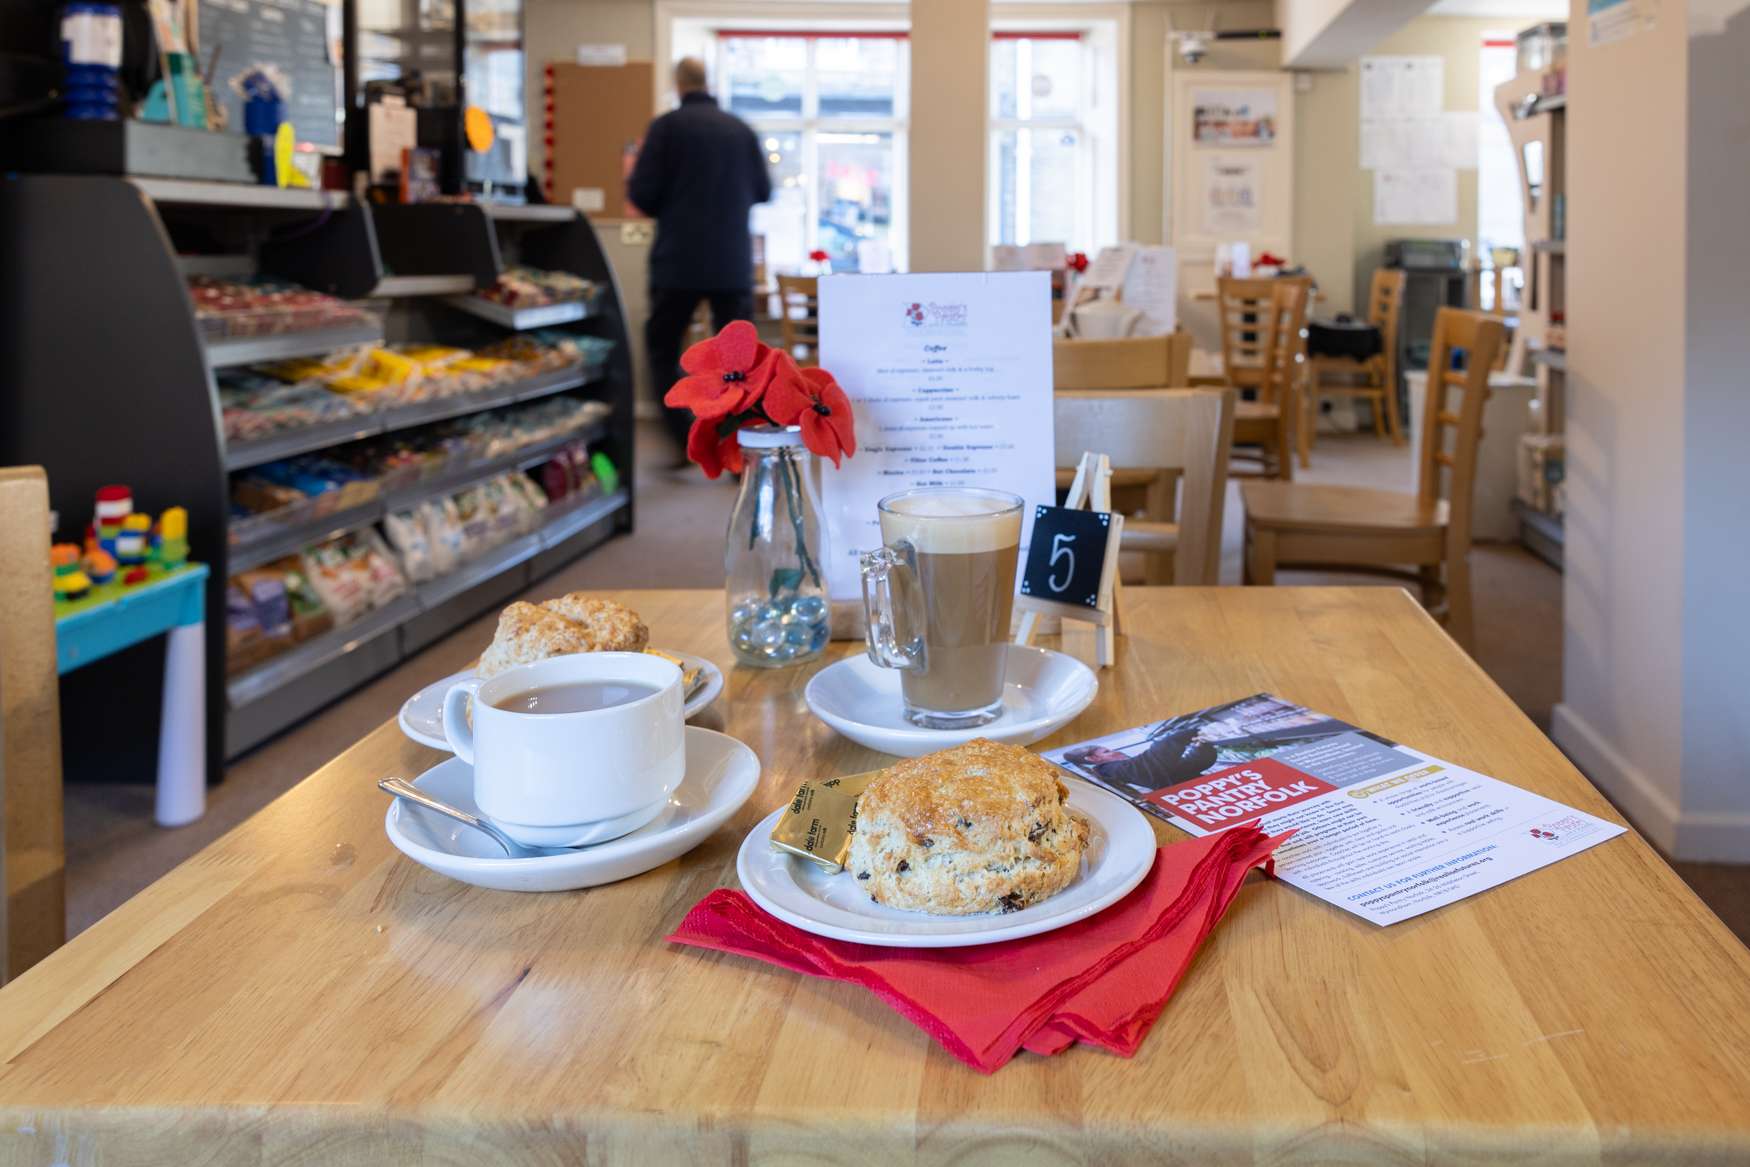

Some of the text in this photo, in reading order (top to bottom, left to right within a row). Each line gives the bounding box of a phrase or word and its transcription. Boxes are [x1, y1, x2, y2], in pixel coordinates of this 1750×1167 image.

[1048, 533, 1076, 592] 5
[1160, 769, 1263, 807] POPPY'S
[1178, 779, 1274, 816] PANTRY
[1195, 780, 1318, 825] NORFOLK
